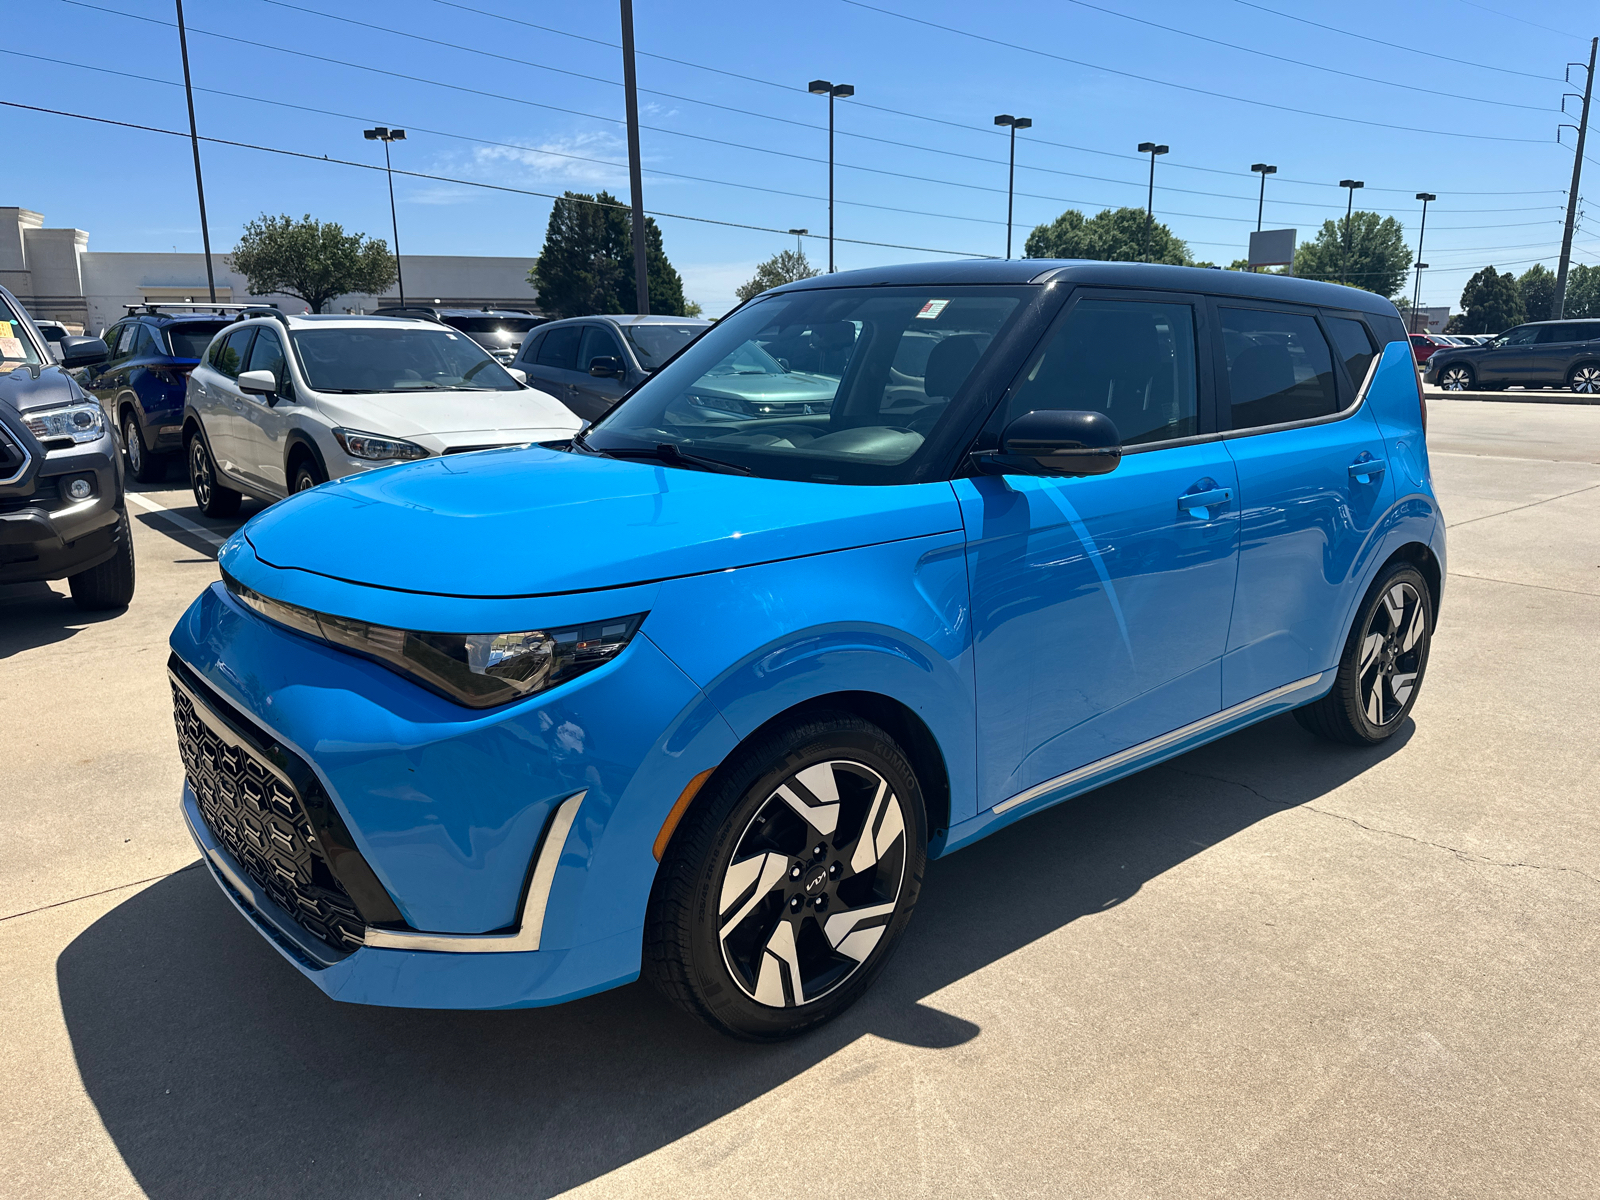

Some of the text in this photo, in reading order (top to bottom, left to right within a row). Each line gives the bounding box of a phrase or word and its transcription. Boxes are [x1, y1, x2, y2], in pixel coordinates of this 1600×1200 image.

[873, 740, 915, 790] KUMHO
[698, 883, 710, 923] 235/45
[705, 849, 720, 880] ZR18
